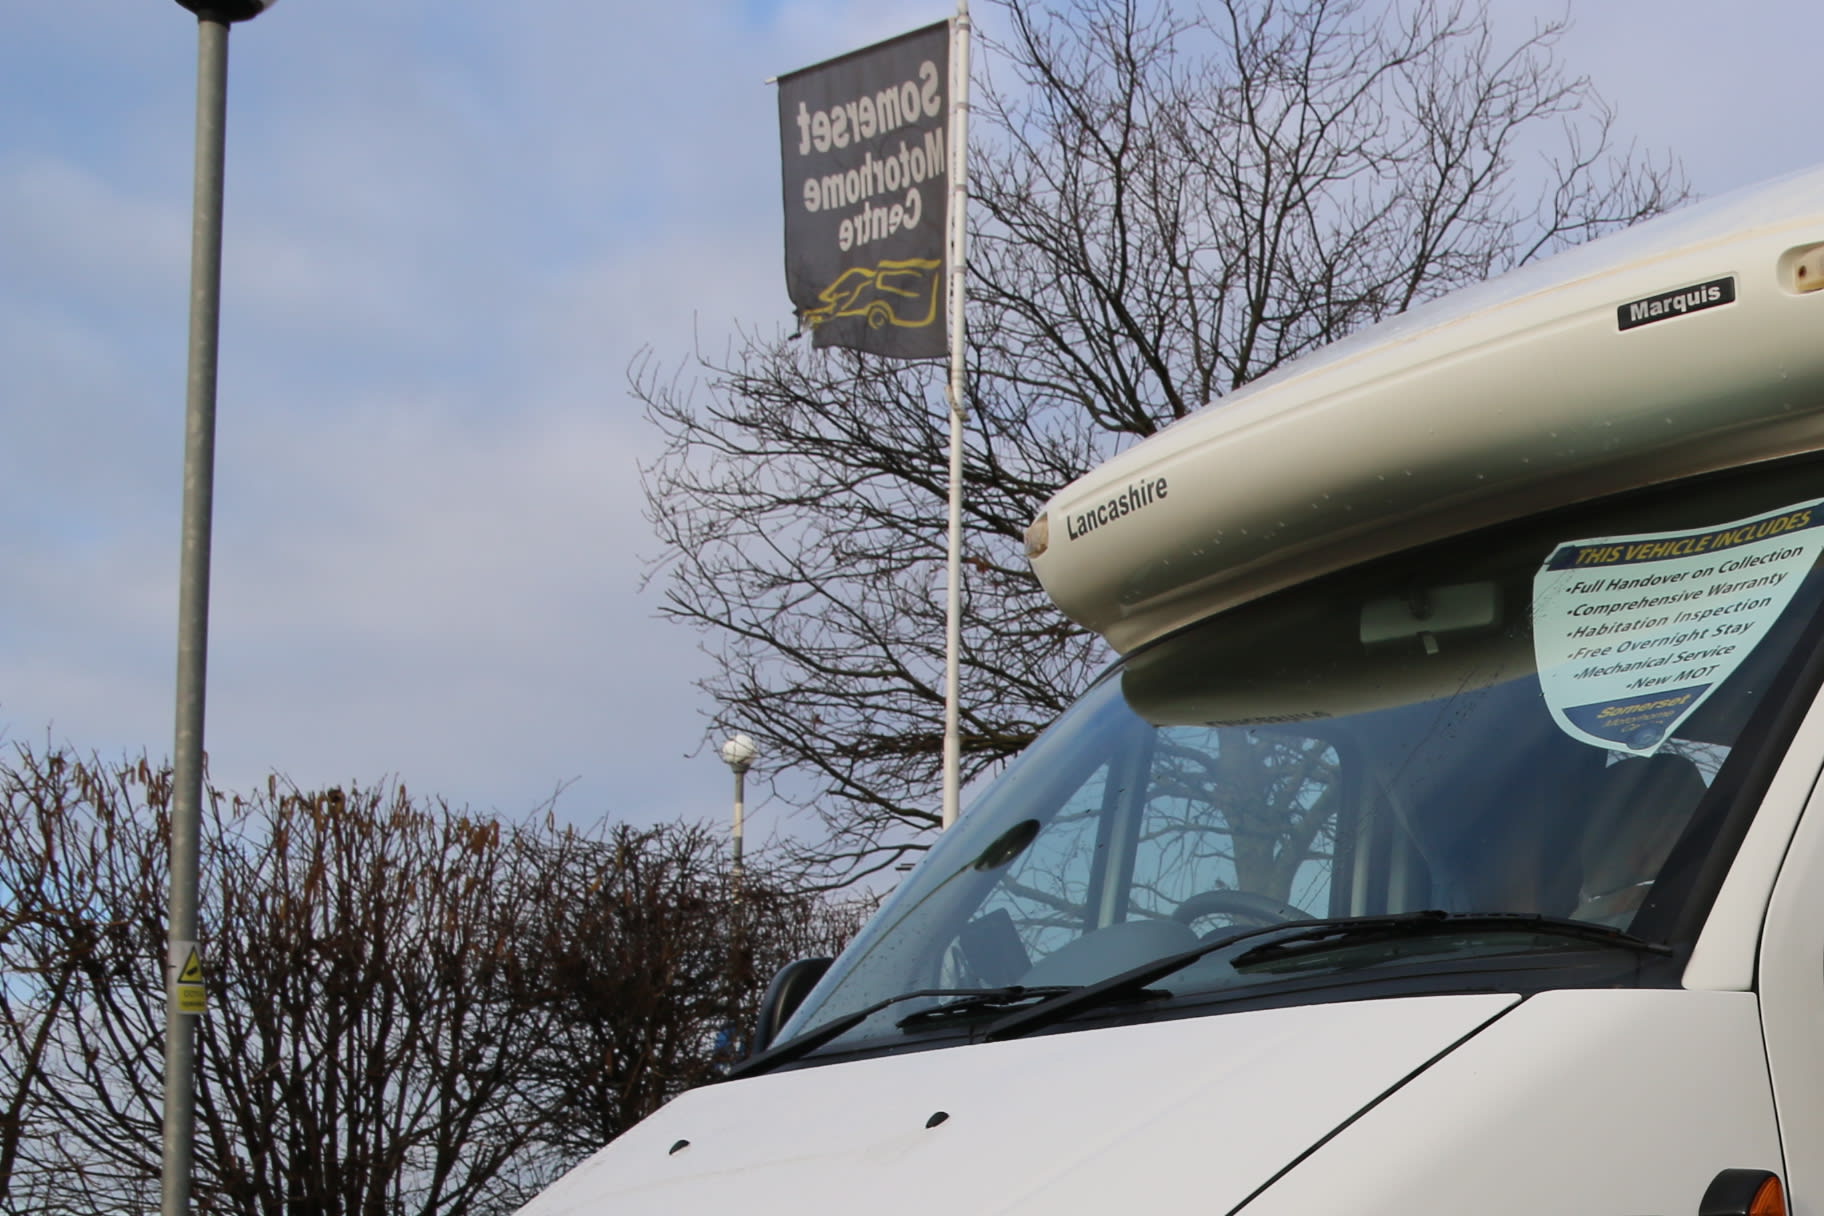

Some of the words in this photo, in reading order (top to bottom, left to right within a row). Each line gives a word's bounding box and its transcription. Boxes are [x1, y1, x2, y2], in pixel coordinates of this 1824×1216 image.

[1629, 284, 1721, 322] Marquis
[1066, 477, 1168, 542] Lancashire
[1575, 545, 1624, 565] THIS
[1624, 535, 1713, 561] VEHICLE
[1711, 510, 1812, 549] INCLUDES
[1571, 580, 1606, 594] Full
[1605, 571, 1691, 592] Handover
[1691, 567, 1715, 579] on
[1718, 546, 1804, 574] Collection
[1573, 589, 1703, 617] Comprehensive
[1707, 571, 1789, 598] Warranty
[1572, 617, 1669, 639] Habitation
[1673, 597, 1772, 623] Inspection
[1573, 645, 1613, 660] Free
[1616, 629, 1709, 653] Overnight
[1711, 621, 1756, 637] Stay
[1578, 653, 1675, 680] Mechanical
[1673, 645, 1737, 664] Service
[1631, 675, 1673, 690] New
[1673, 664, 1721, 683] MOT
[1596, 693, 1692, 719] Somerset
